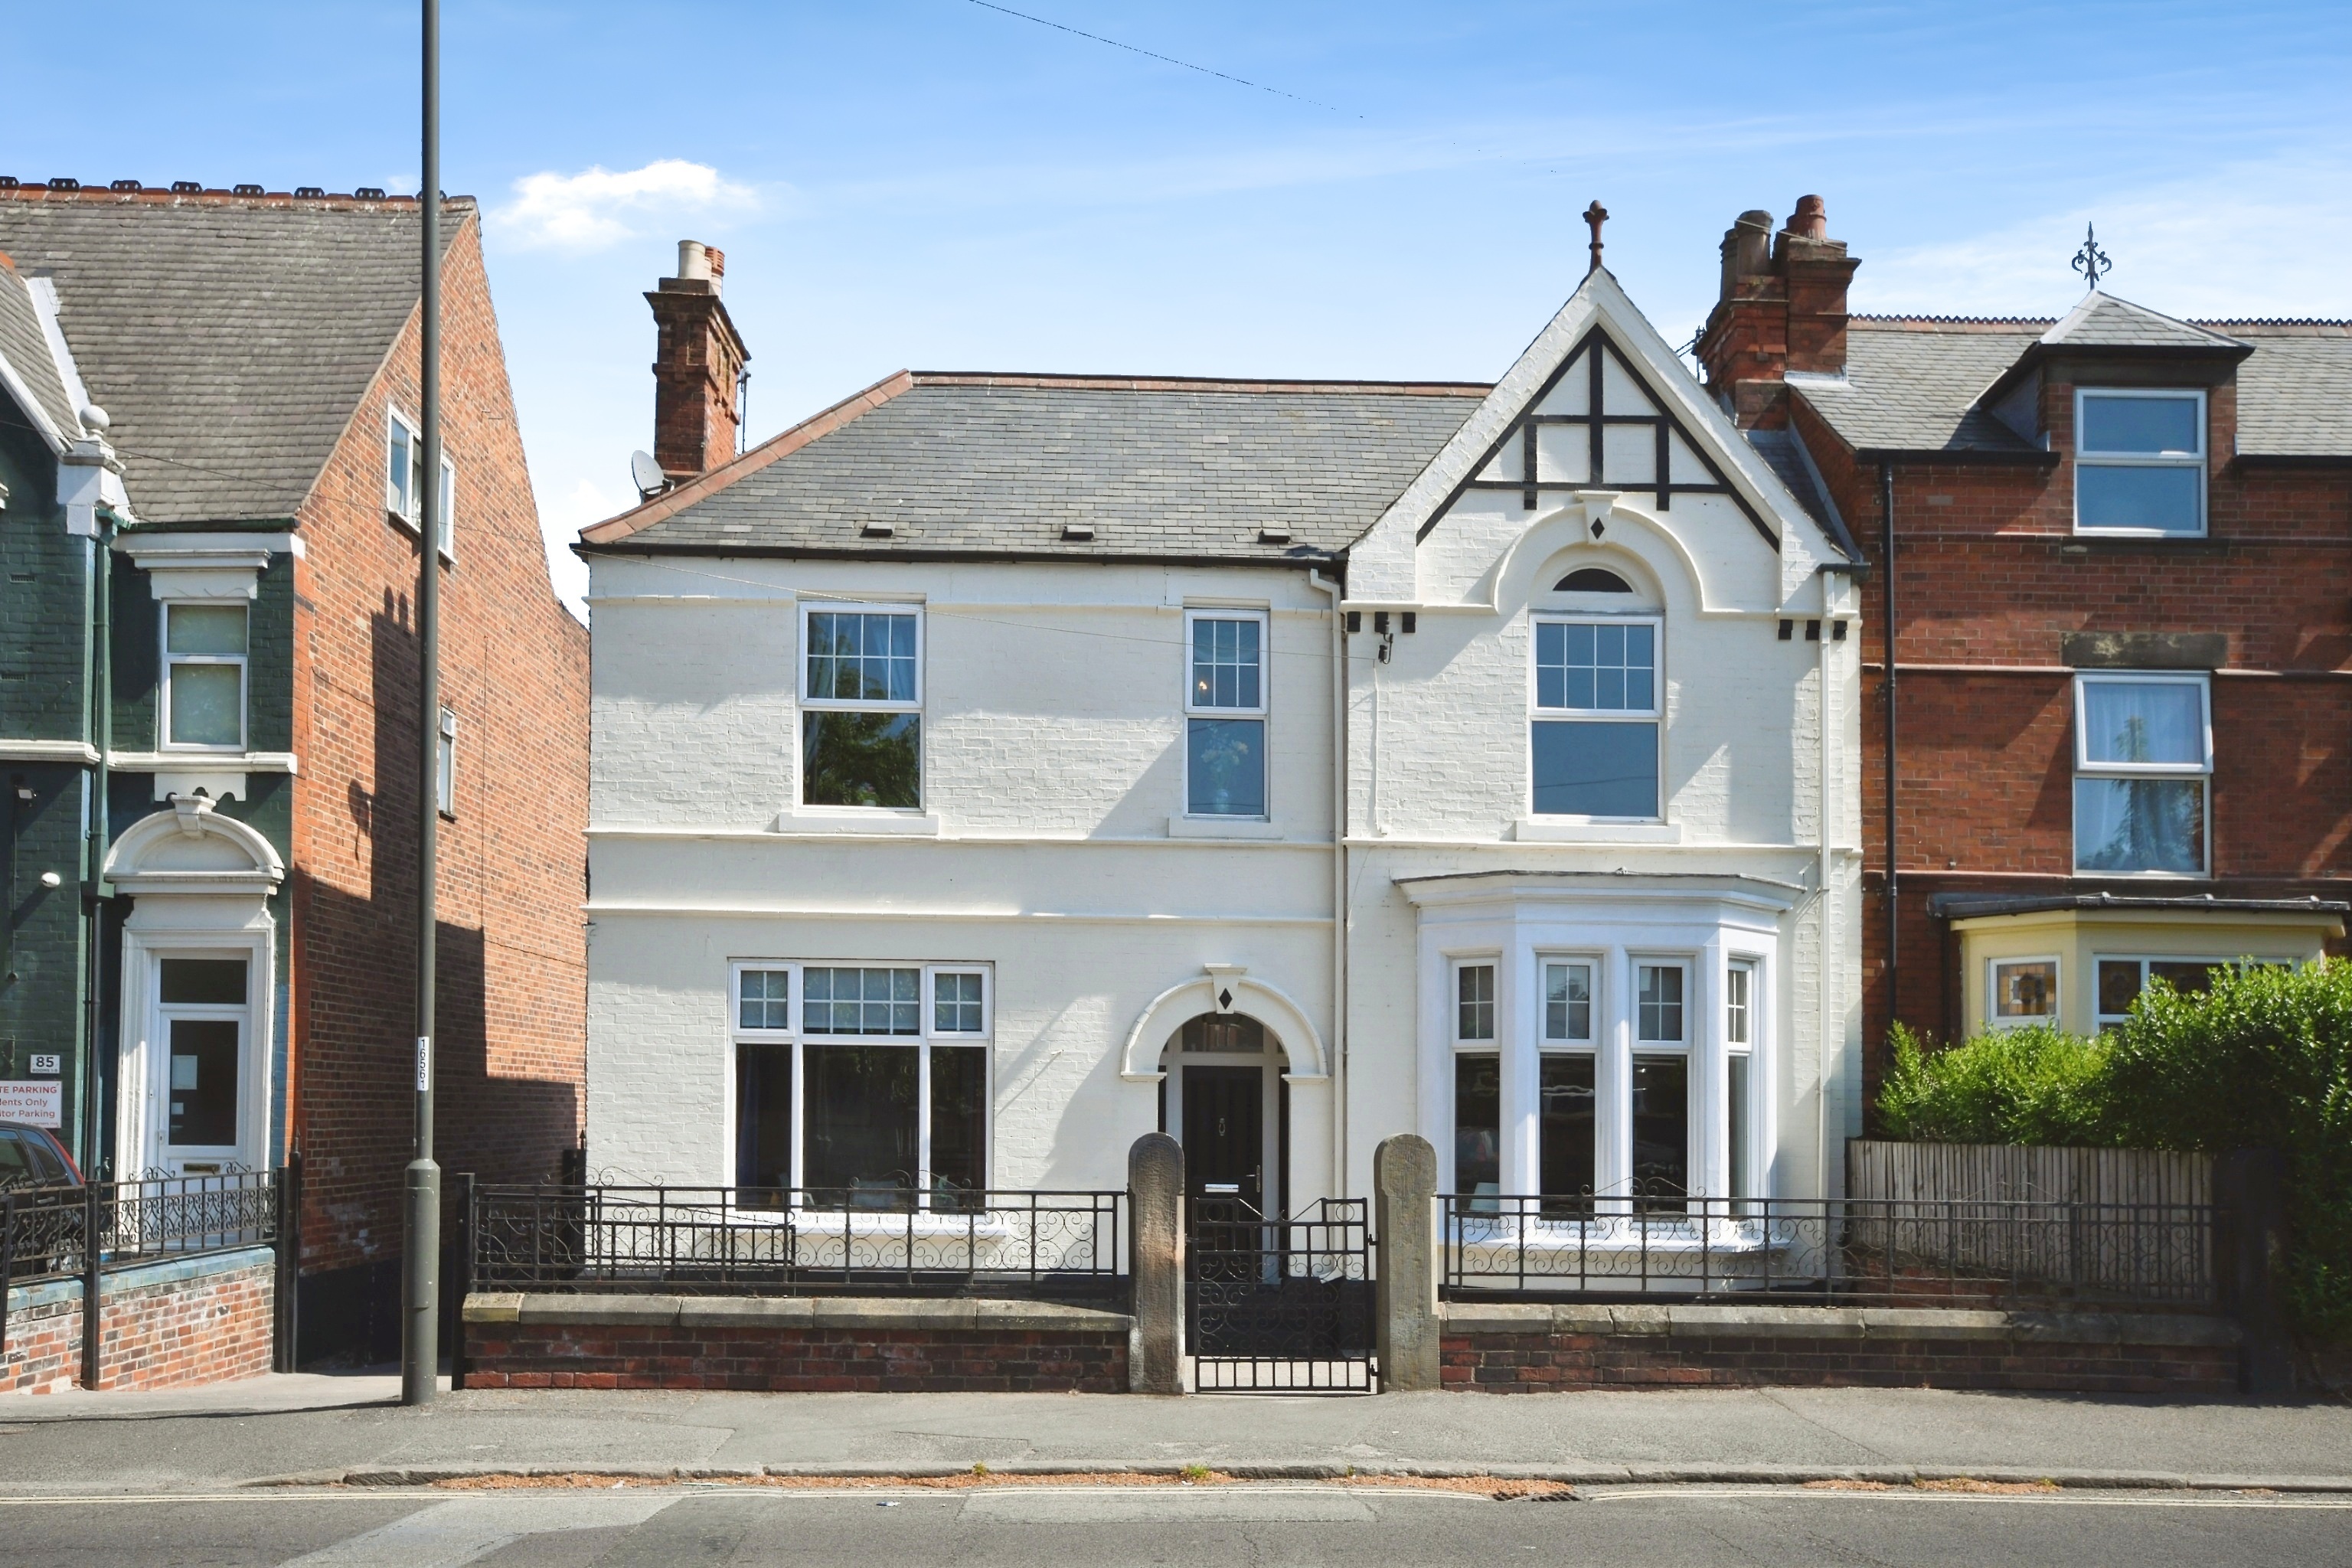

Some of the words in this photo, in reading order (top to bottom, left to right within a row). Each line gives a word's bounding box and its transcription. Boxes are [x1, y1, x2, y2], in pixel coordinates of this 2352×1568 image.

[36, 1057, 54, 1067] 85
[26, 1098, 48, 1107] Only
[19, 1109, 55, 1119] Parking
